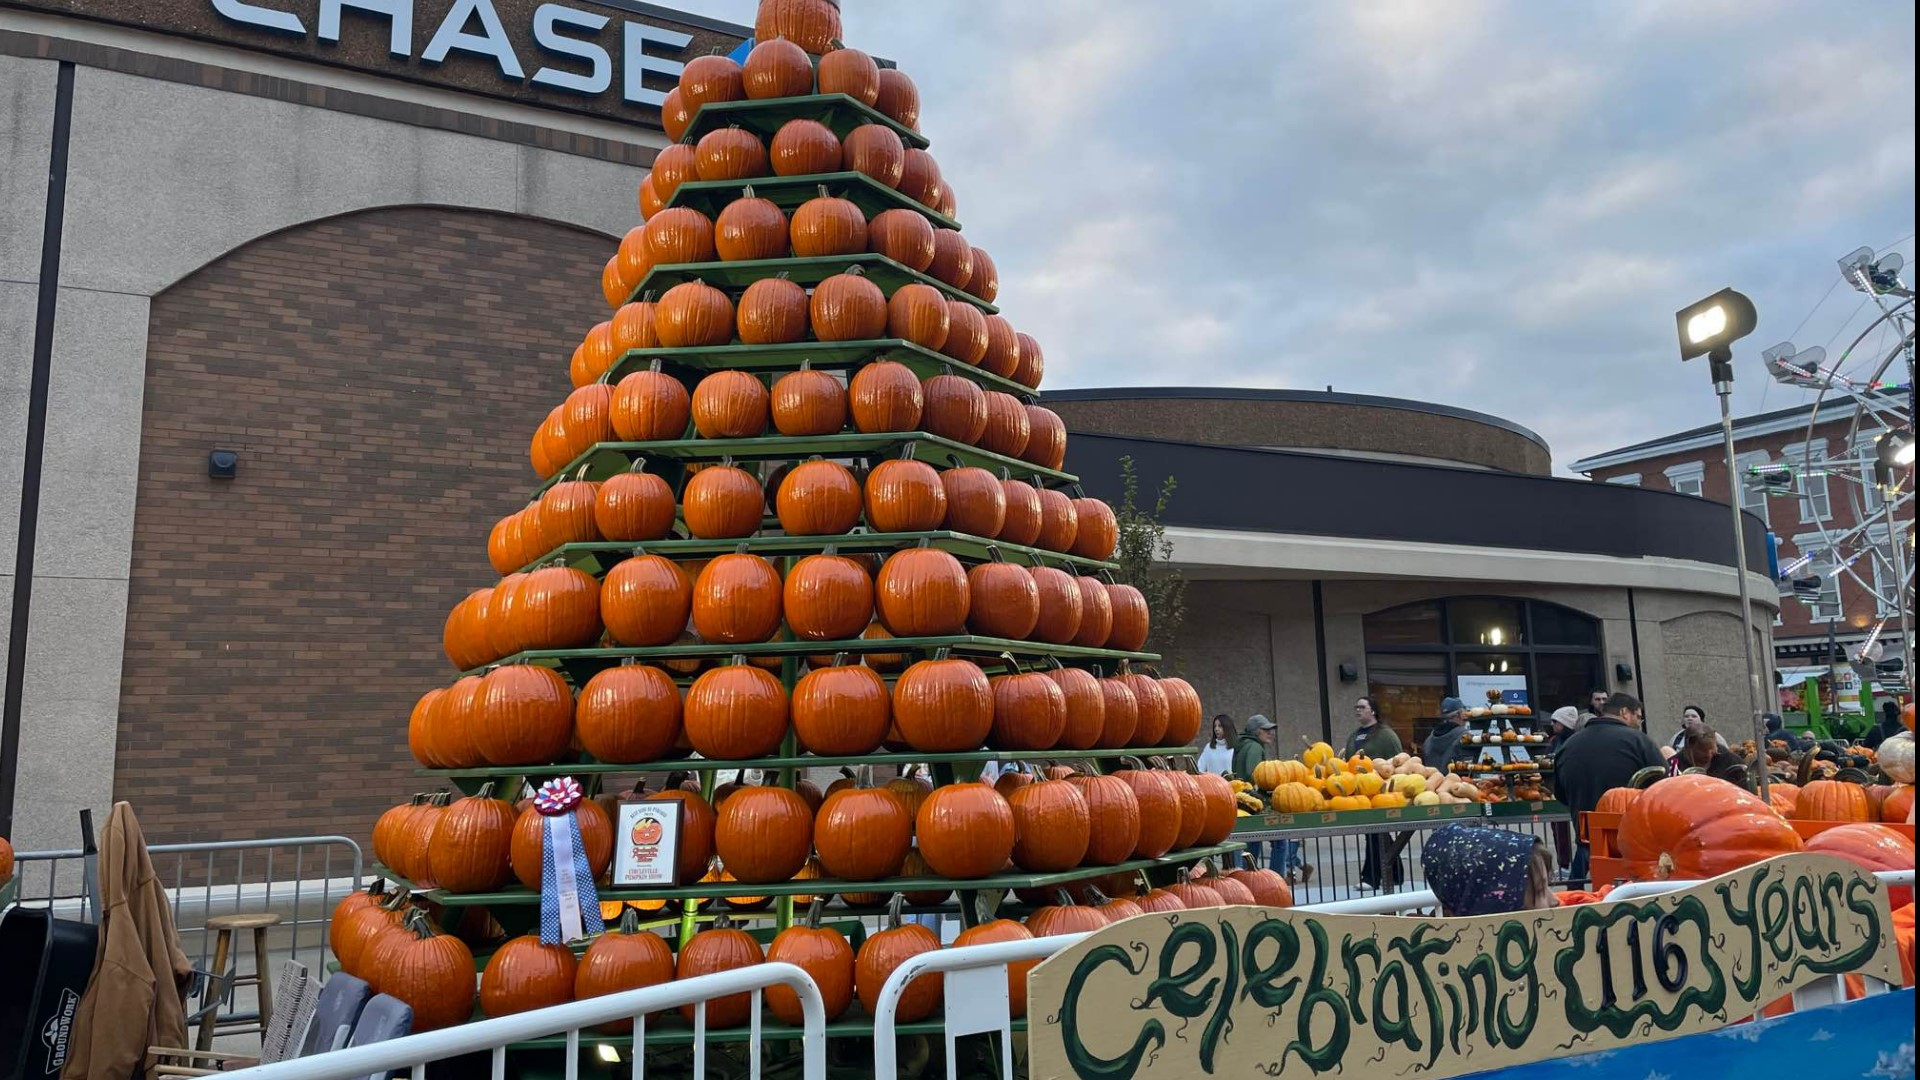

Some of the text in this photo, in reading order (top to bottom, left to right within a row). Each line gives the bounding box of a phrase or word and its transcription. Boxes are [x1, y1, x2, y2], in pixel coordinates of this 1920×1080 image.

[52, 997, 77, 1067] GROUNDWORK
[1061, 918, 1540, 1080] Celebrating
[1596, 914, 1688, 1009] 116
